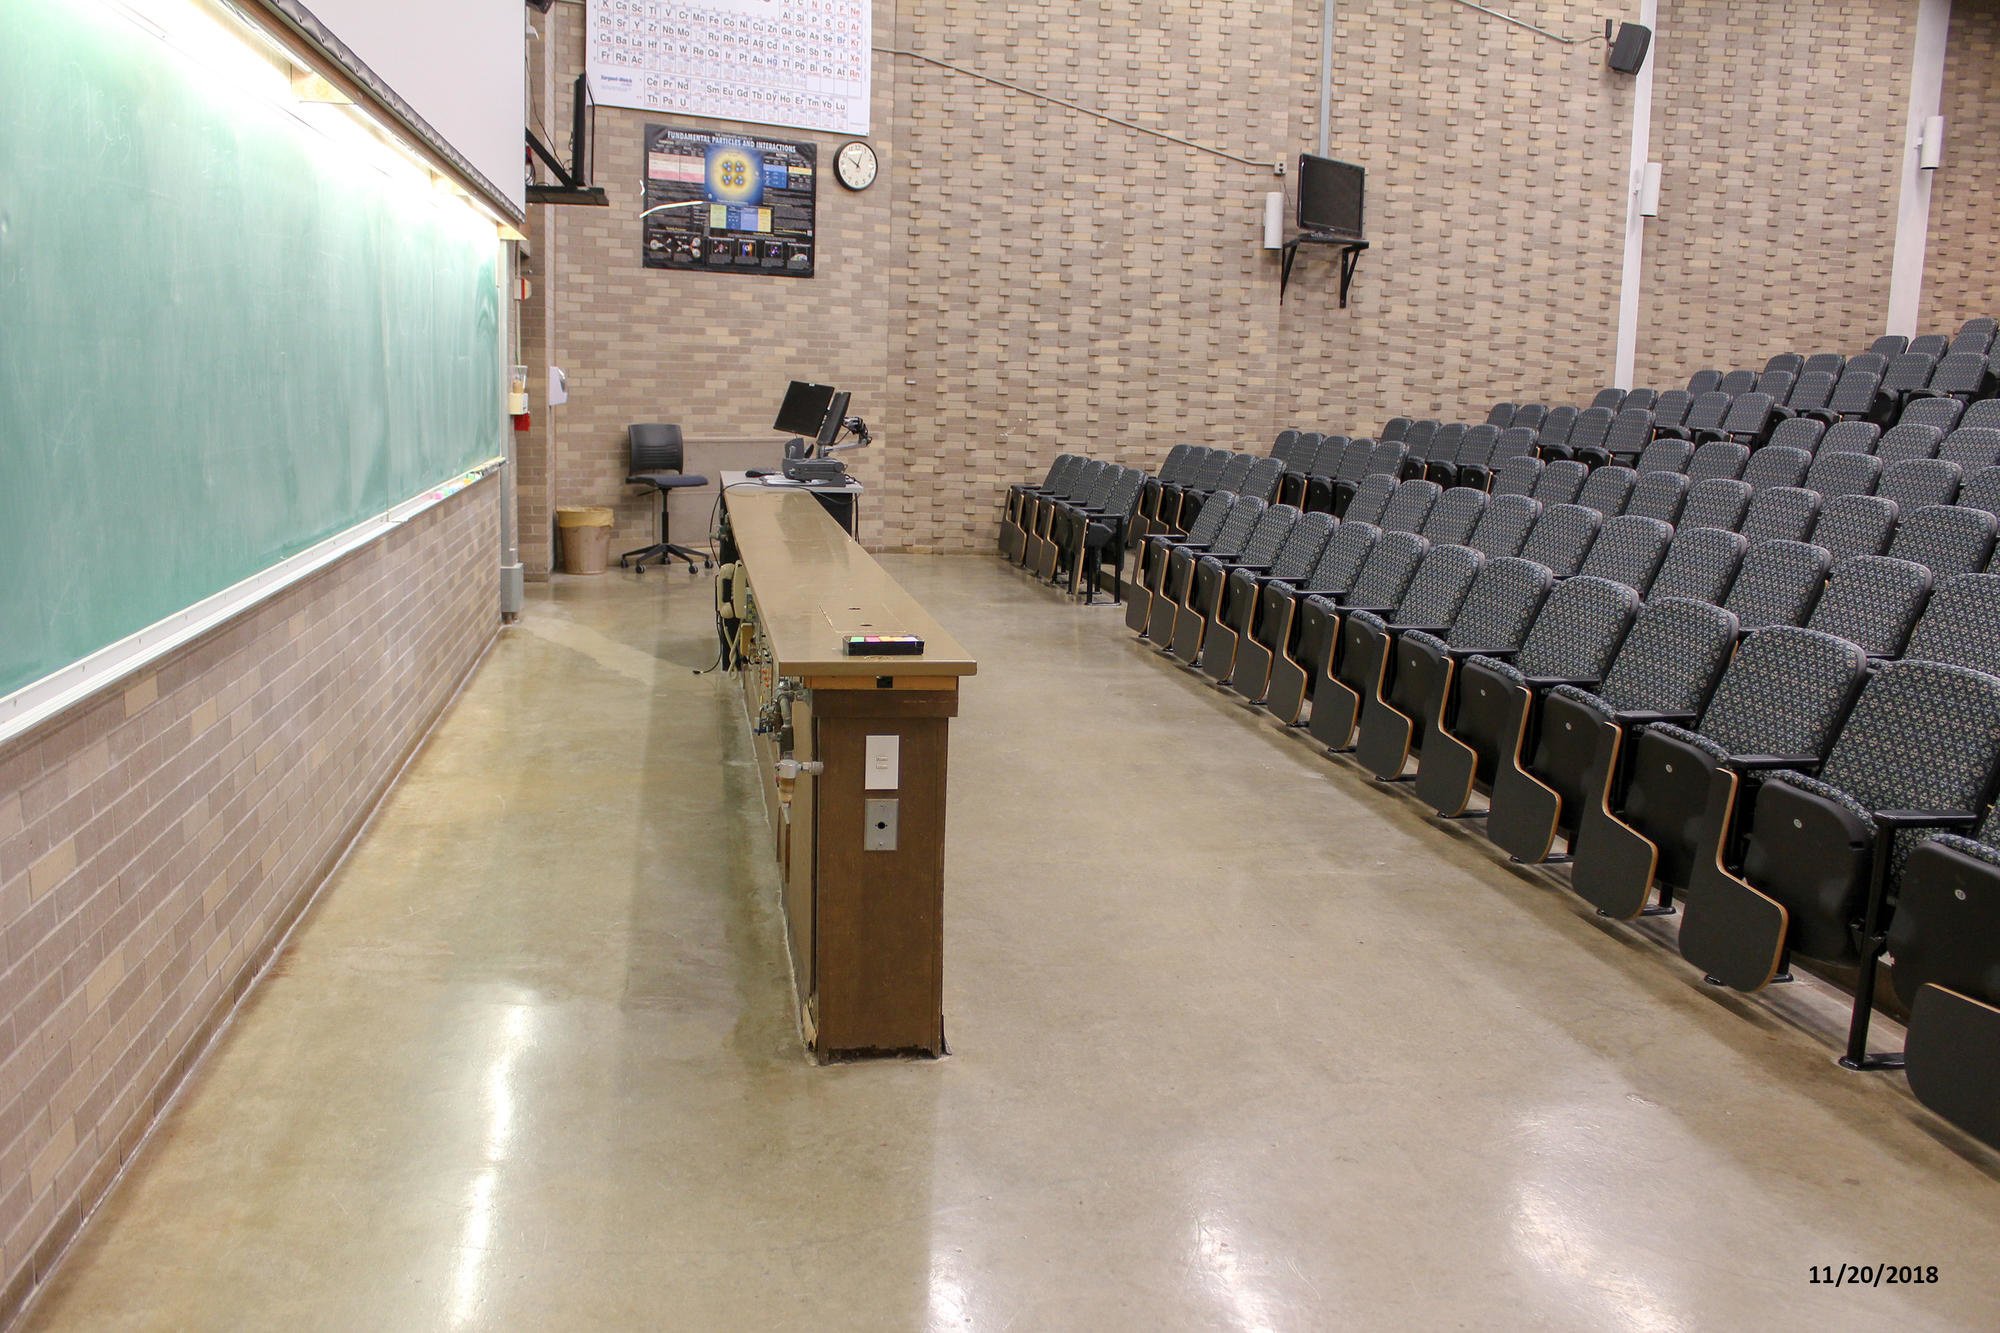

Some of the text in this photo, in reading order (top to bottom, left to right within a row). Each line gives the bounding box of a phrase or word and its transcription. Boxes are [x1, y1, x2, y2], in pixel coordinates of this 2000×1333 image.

[616, 2, 627, 10] Ca
[632, 4, 642, 13] Sc
[679, 11, 689, 20] Cr
[693, 14, 705, 22] Mn
[709, 16, 719, 24] Fe
[600, 16, 611, 25] Rb
[617, 19, 626, 27] Sr
[634, 21, 640, 29] Y
[663, 26, 673, 34] Nb
[678, 28, 690, 36] Mo
[753, 39, 763, 48] Ag
[809, 48, 819, 56] Sb
[600, 34, 611, 42] Cs
[616, 36, 627, 44] Ba
[632, 39, 642, 47] La
[694, 47, 704, 55] Re
[708, 49, 719, 57] Os
[767, 57, 777, 66] Hg
[795, 62, 805, 70] Pb
[616, 53, 627, 62] Ra
[631, 55, 642, 64] Ac
[647, 78, 658, 86] Ce
[678, 81, 688, 90] Nd
[737, 89, 748, 97] Gd
[766, 93, 776, 102] Dy
[808, 98, 819, 107] Tm
[667, 130, 710, 143] FUNDAMENTAL
[711, 135, 741, 146] PARTICLES
[756, 141, 796, 153] INTERACTIONS
